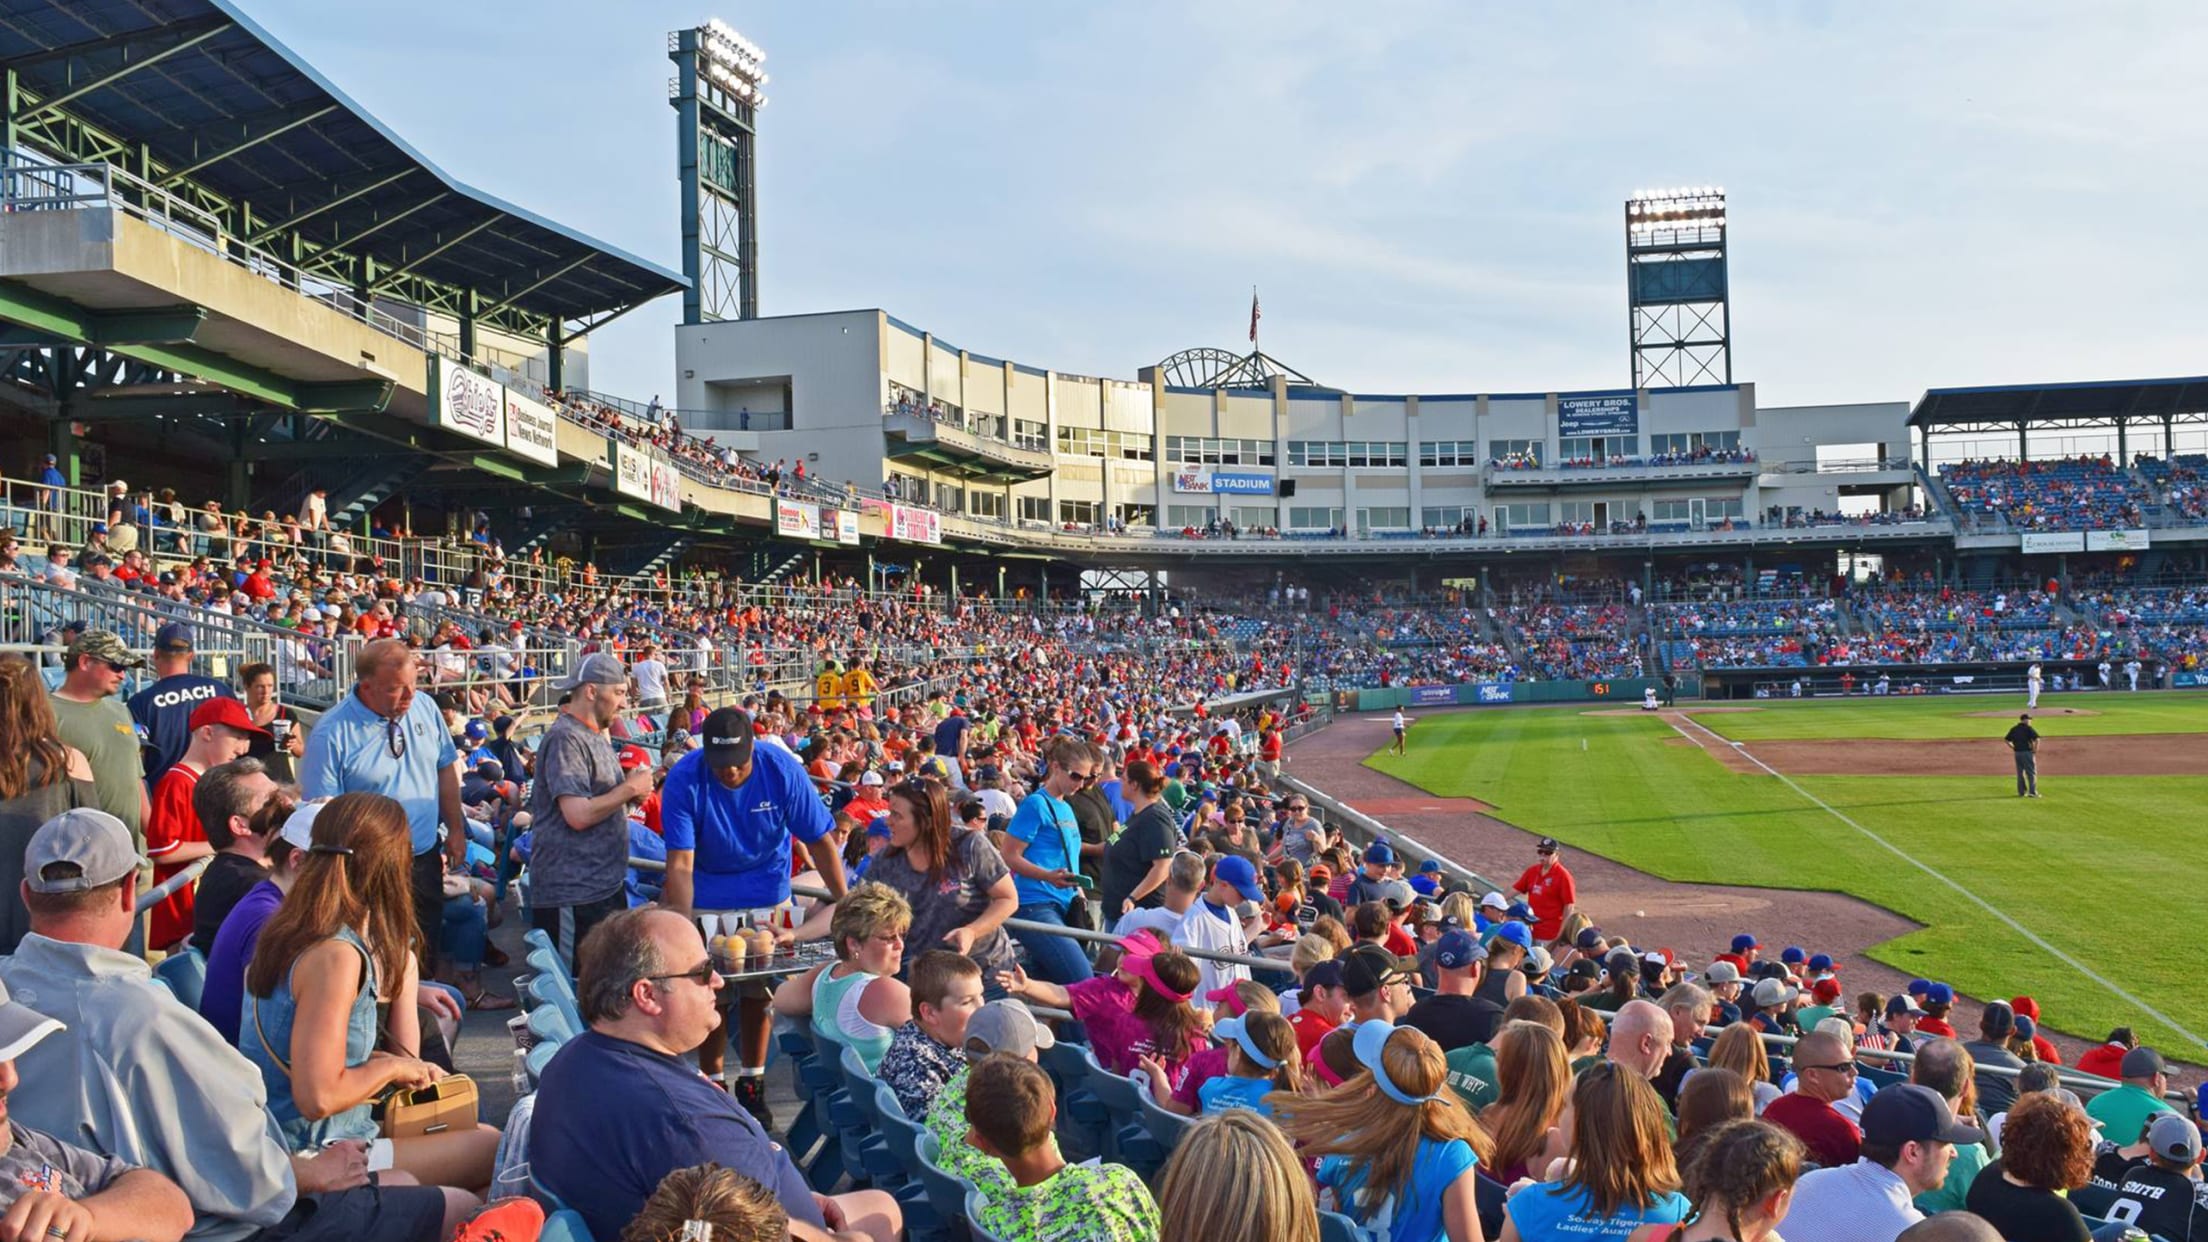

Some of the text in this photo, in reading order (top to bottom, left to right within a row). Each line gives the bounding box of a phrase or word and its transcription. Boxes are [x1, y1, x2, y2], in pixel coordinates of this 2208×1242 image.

[1564, 399, 1632, 409] LOWERY BROS.
[518, 423, 532, 442] News
[1184, 481, 1209, 490] BANK
[1215, 478, 1270, 488] STADIUM
[823, 681, 831, 694] 3
[851, 679, 860, 692] 9
[154, 684, 217, 708] COACH
[2122, 1181, 2166, 1200] SMITH
[1556, 1221, 1599, 1234] Ladies'
